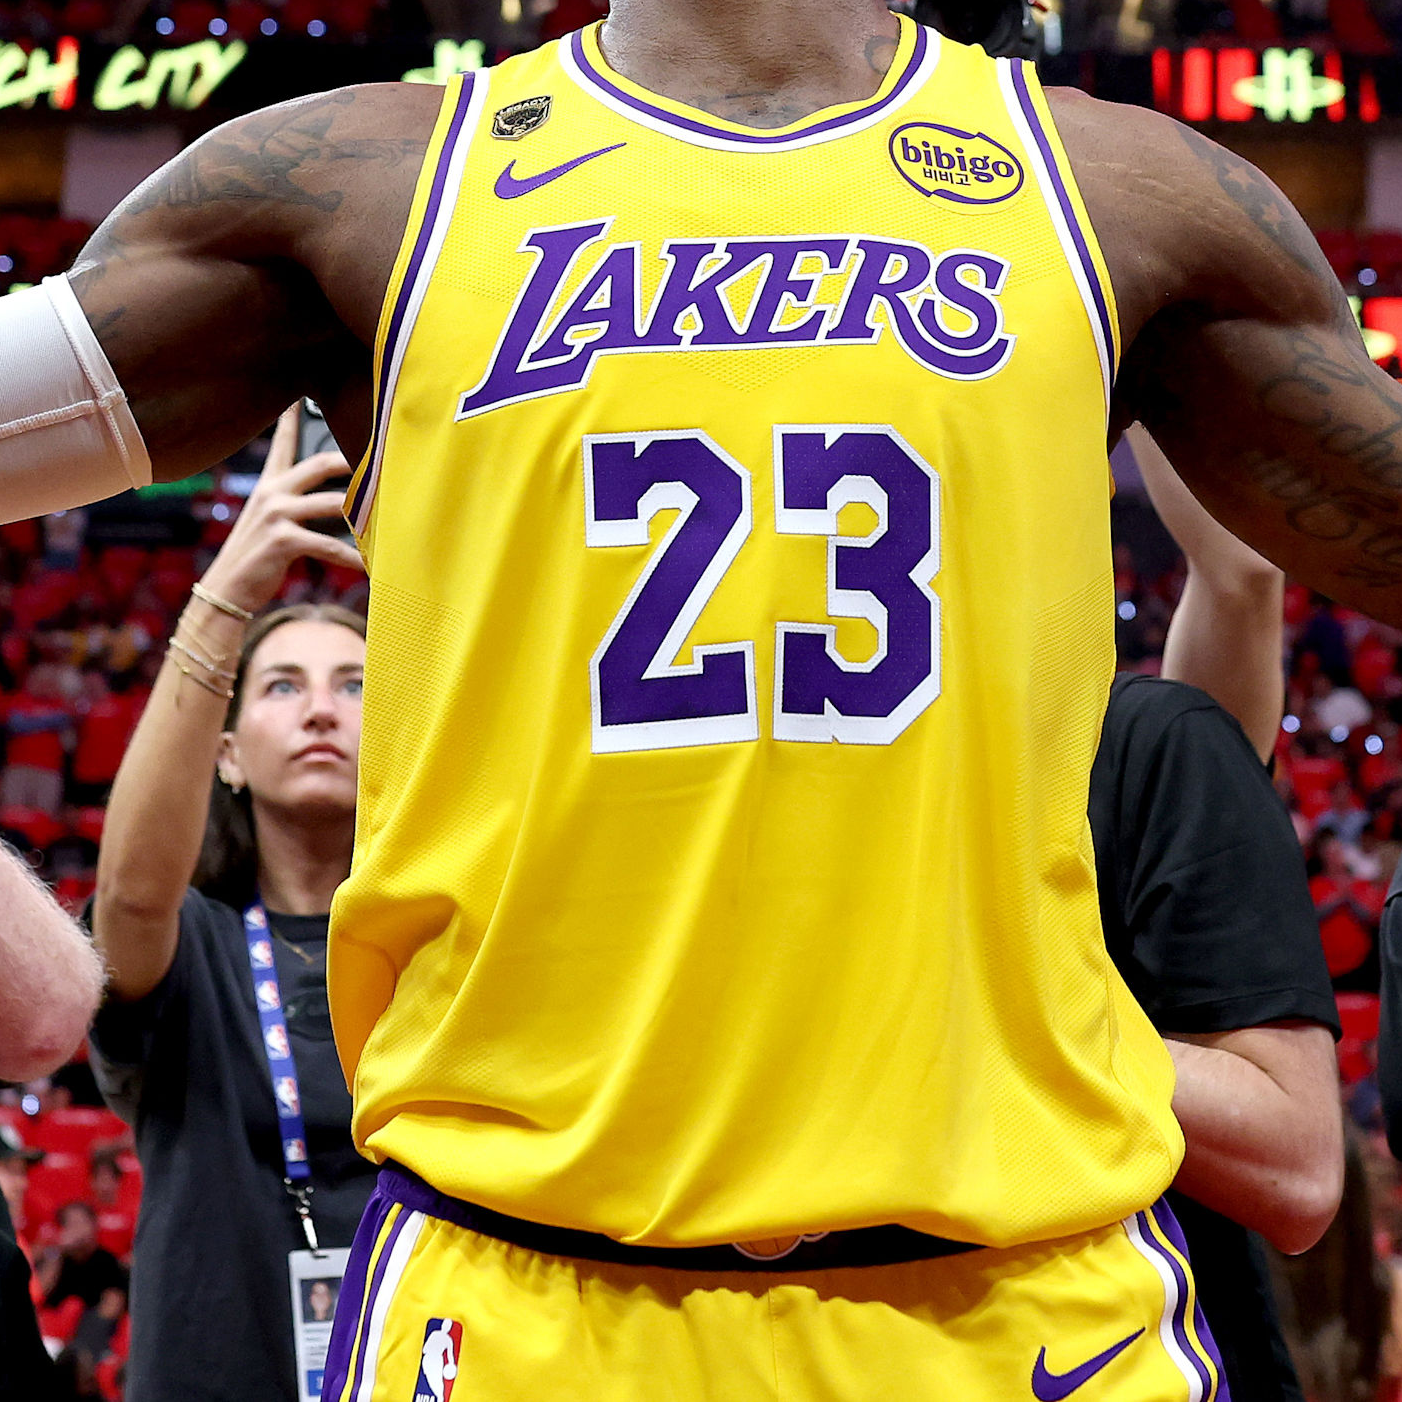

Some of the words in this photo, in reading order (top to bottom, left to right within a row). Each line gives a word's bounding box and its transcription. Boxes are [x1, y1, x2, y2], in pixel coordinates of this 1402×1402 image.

[94, 38, 246, 111] CITY
[900, 137, 1015, 184] bibigo
[922, 167, 972, 186] 비비고
[455, 215, 1017, 422] LAKERS
[582, 424, 941, 754] 23
